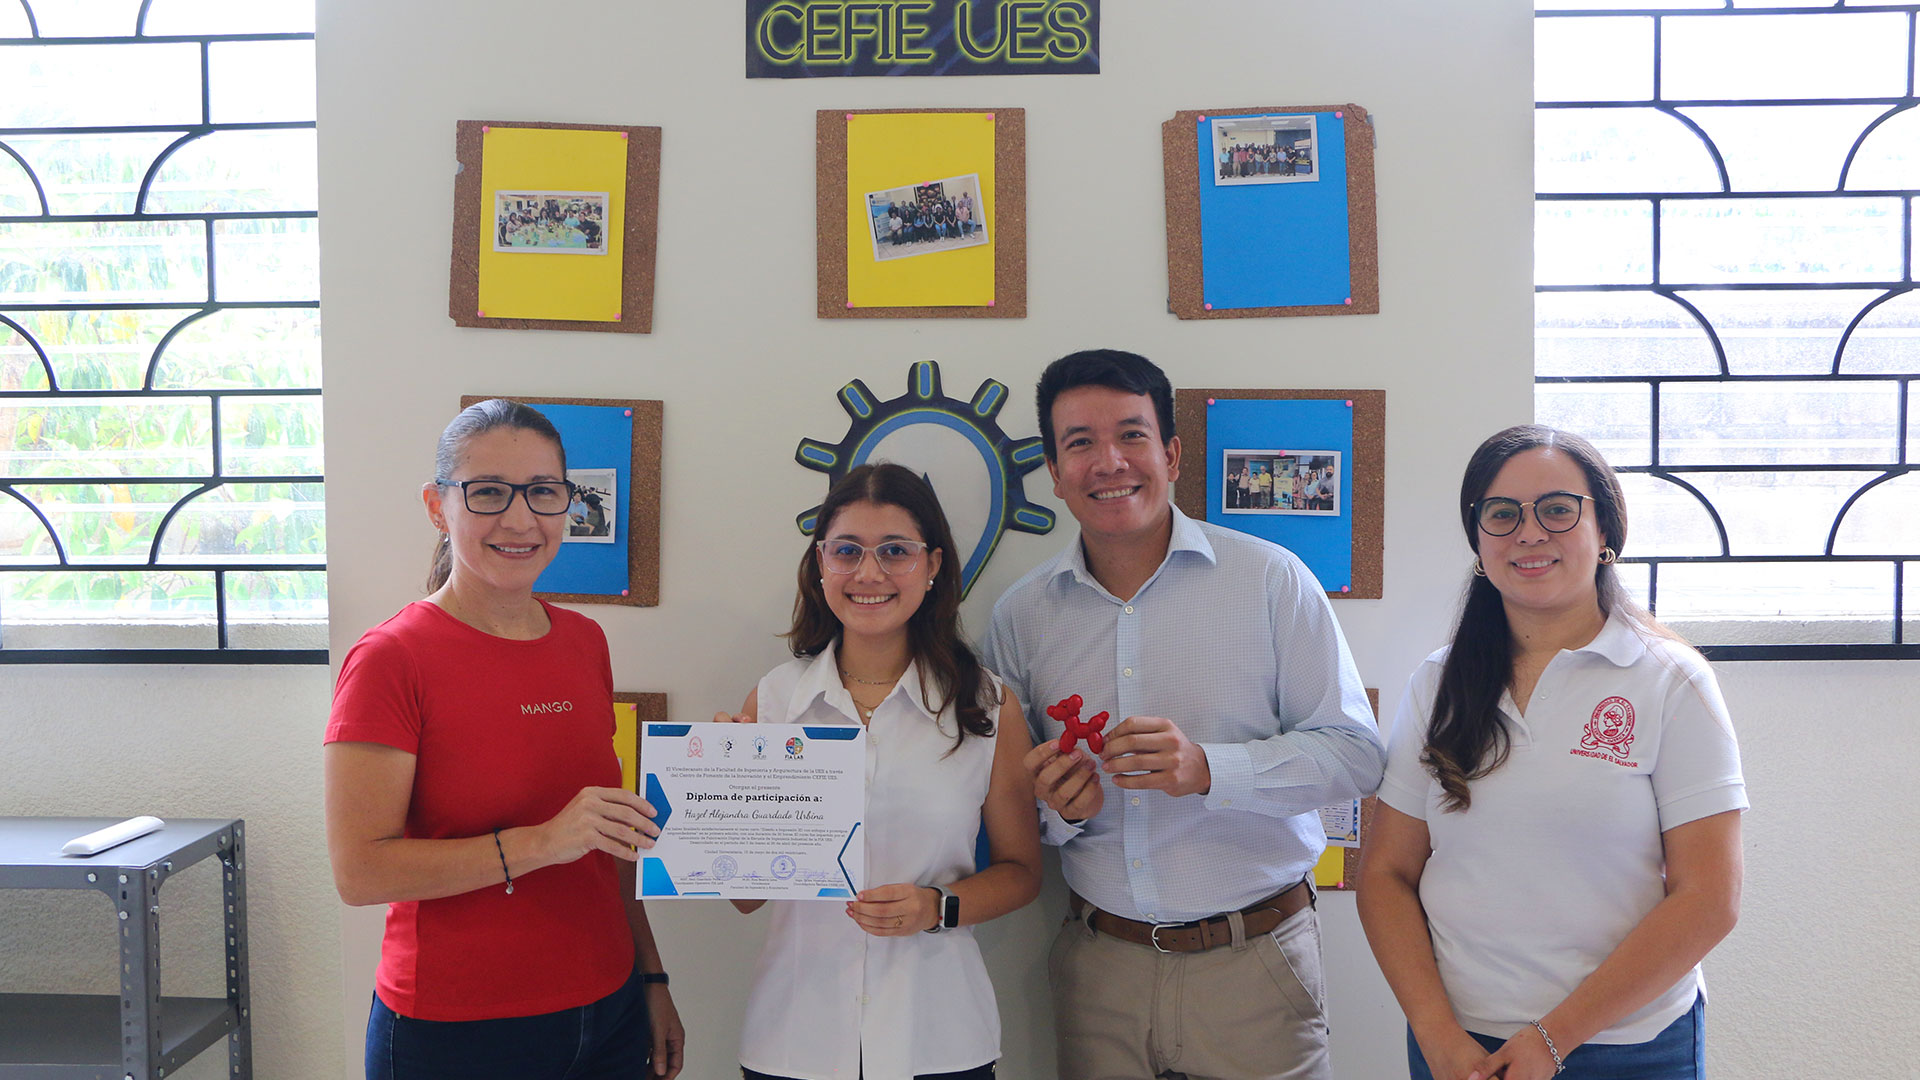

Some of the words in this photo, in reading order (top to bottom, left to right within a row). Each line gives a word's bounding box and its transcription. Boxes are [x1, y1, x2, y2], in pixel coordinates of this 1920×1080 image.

[758, 1, 934, 61] CEFIE
[956, 0, 1089, 60] UES
[520, 700, 573, 715] MANGO
[1570, 749, 1600, 758] UNIVERSIDAD
[1614, 758, 1638, 768] SALVADOR
[686, 792, 729, 802] Diploma
[731, 793, 743, 801] de
[745, 793, 812, 803] participación
[684, 809, 709, 821] Hazel
[708, 809, 749, 821] Alejandra
[752, 809, 793, 820] Guardado
[794, 809, 825, 821] Urbina
